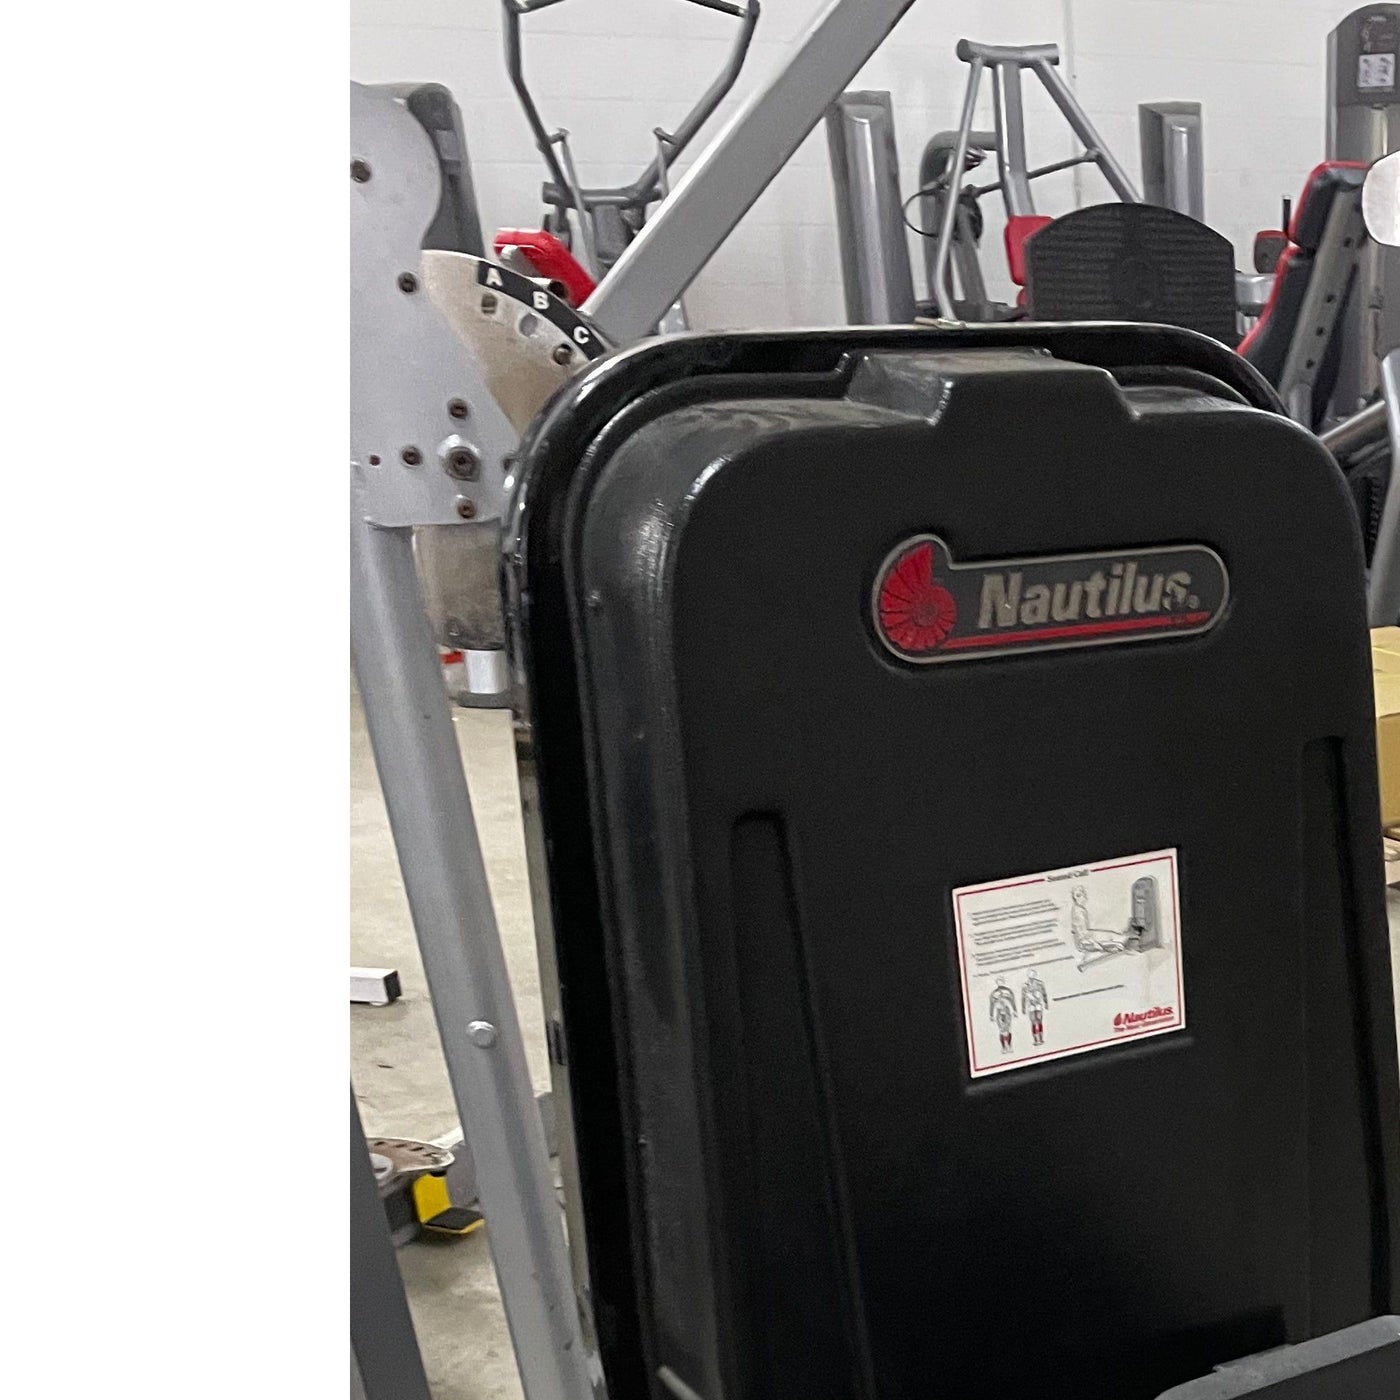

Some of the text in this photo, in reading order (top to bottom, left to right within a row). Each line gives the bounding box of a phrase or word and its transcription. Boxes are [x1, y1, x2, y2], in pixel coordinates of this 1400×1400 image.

[485, 267, 591, 344] A B C
